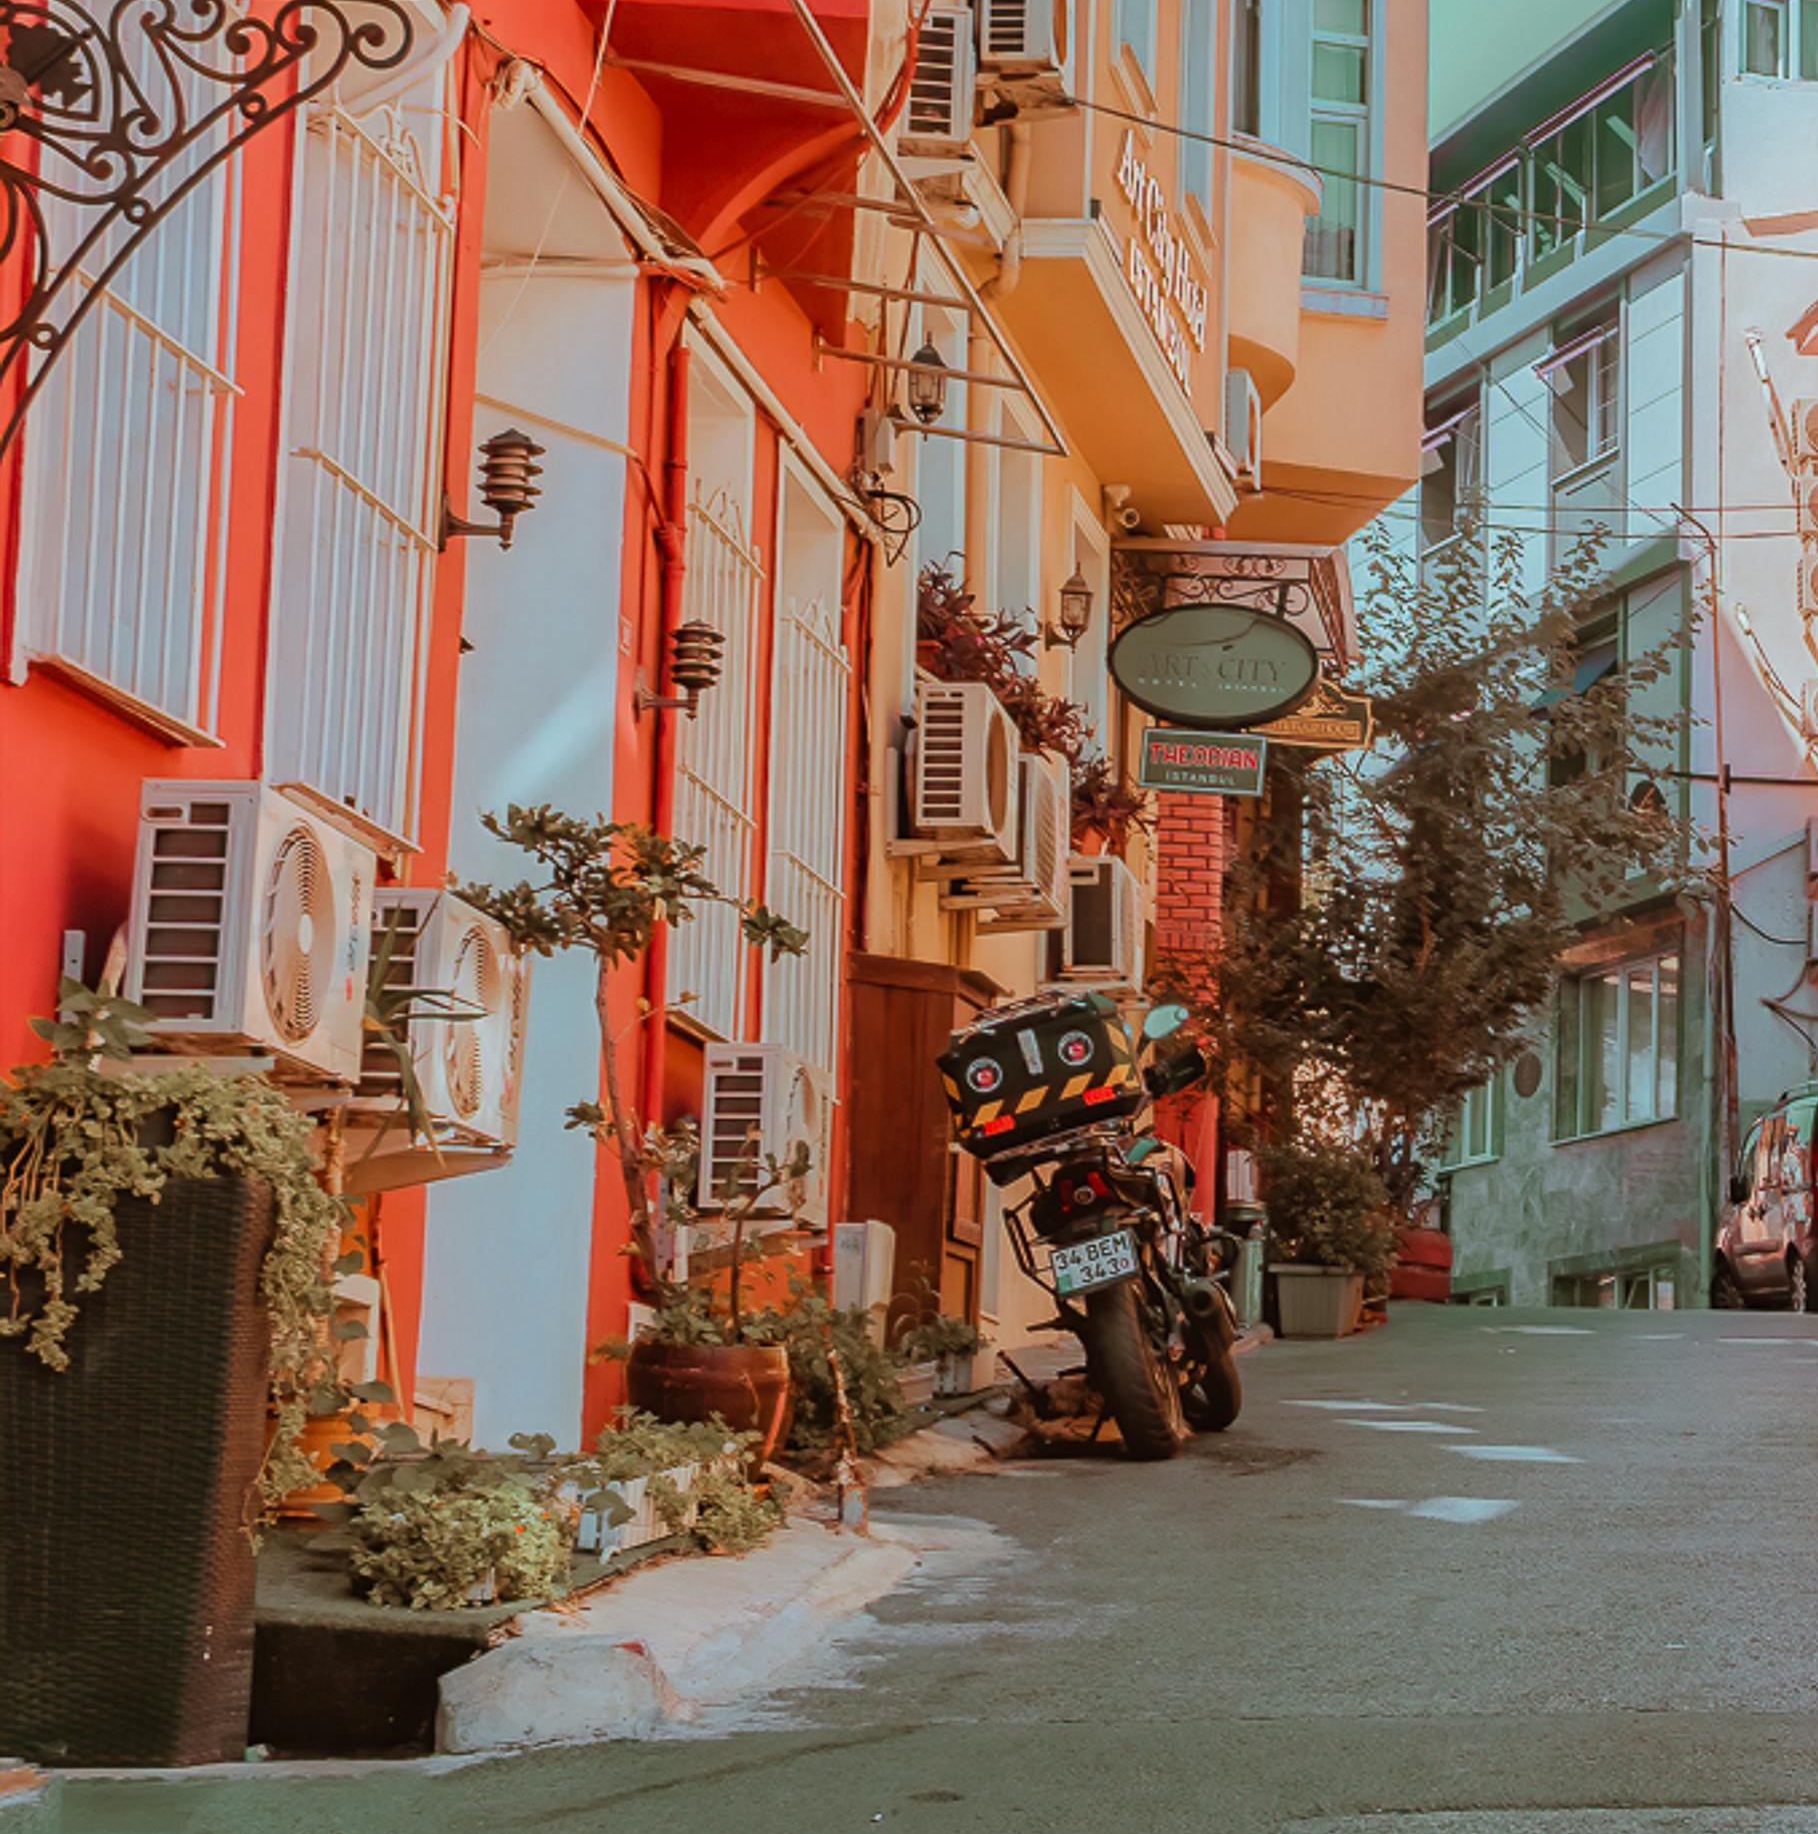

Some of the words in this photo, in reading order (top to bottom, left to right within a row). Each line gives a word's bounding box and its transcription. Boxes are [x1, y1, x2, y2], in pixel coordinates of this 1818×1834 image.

[1117, 129, 1145, 222] Art
[1147, 176, 1175, 299] City
[1175, 238, 1208, 355] Hotel
[1138, 652, 1199, 678] ART
[1217, 657, 1286, 683] CITY
[1056, 1249, 1081, 1270] 34
